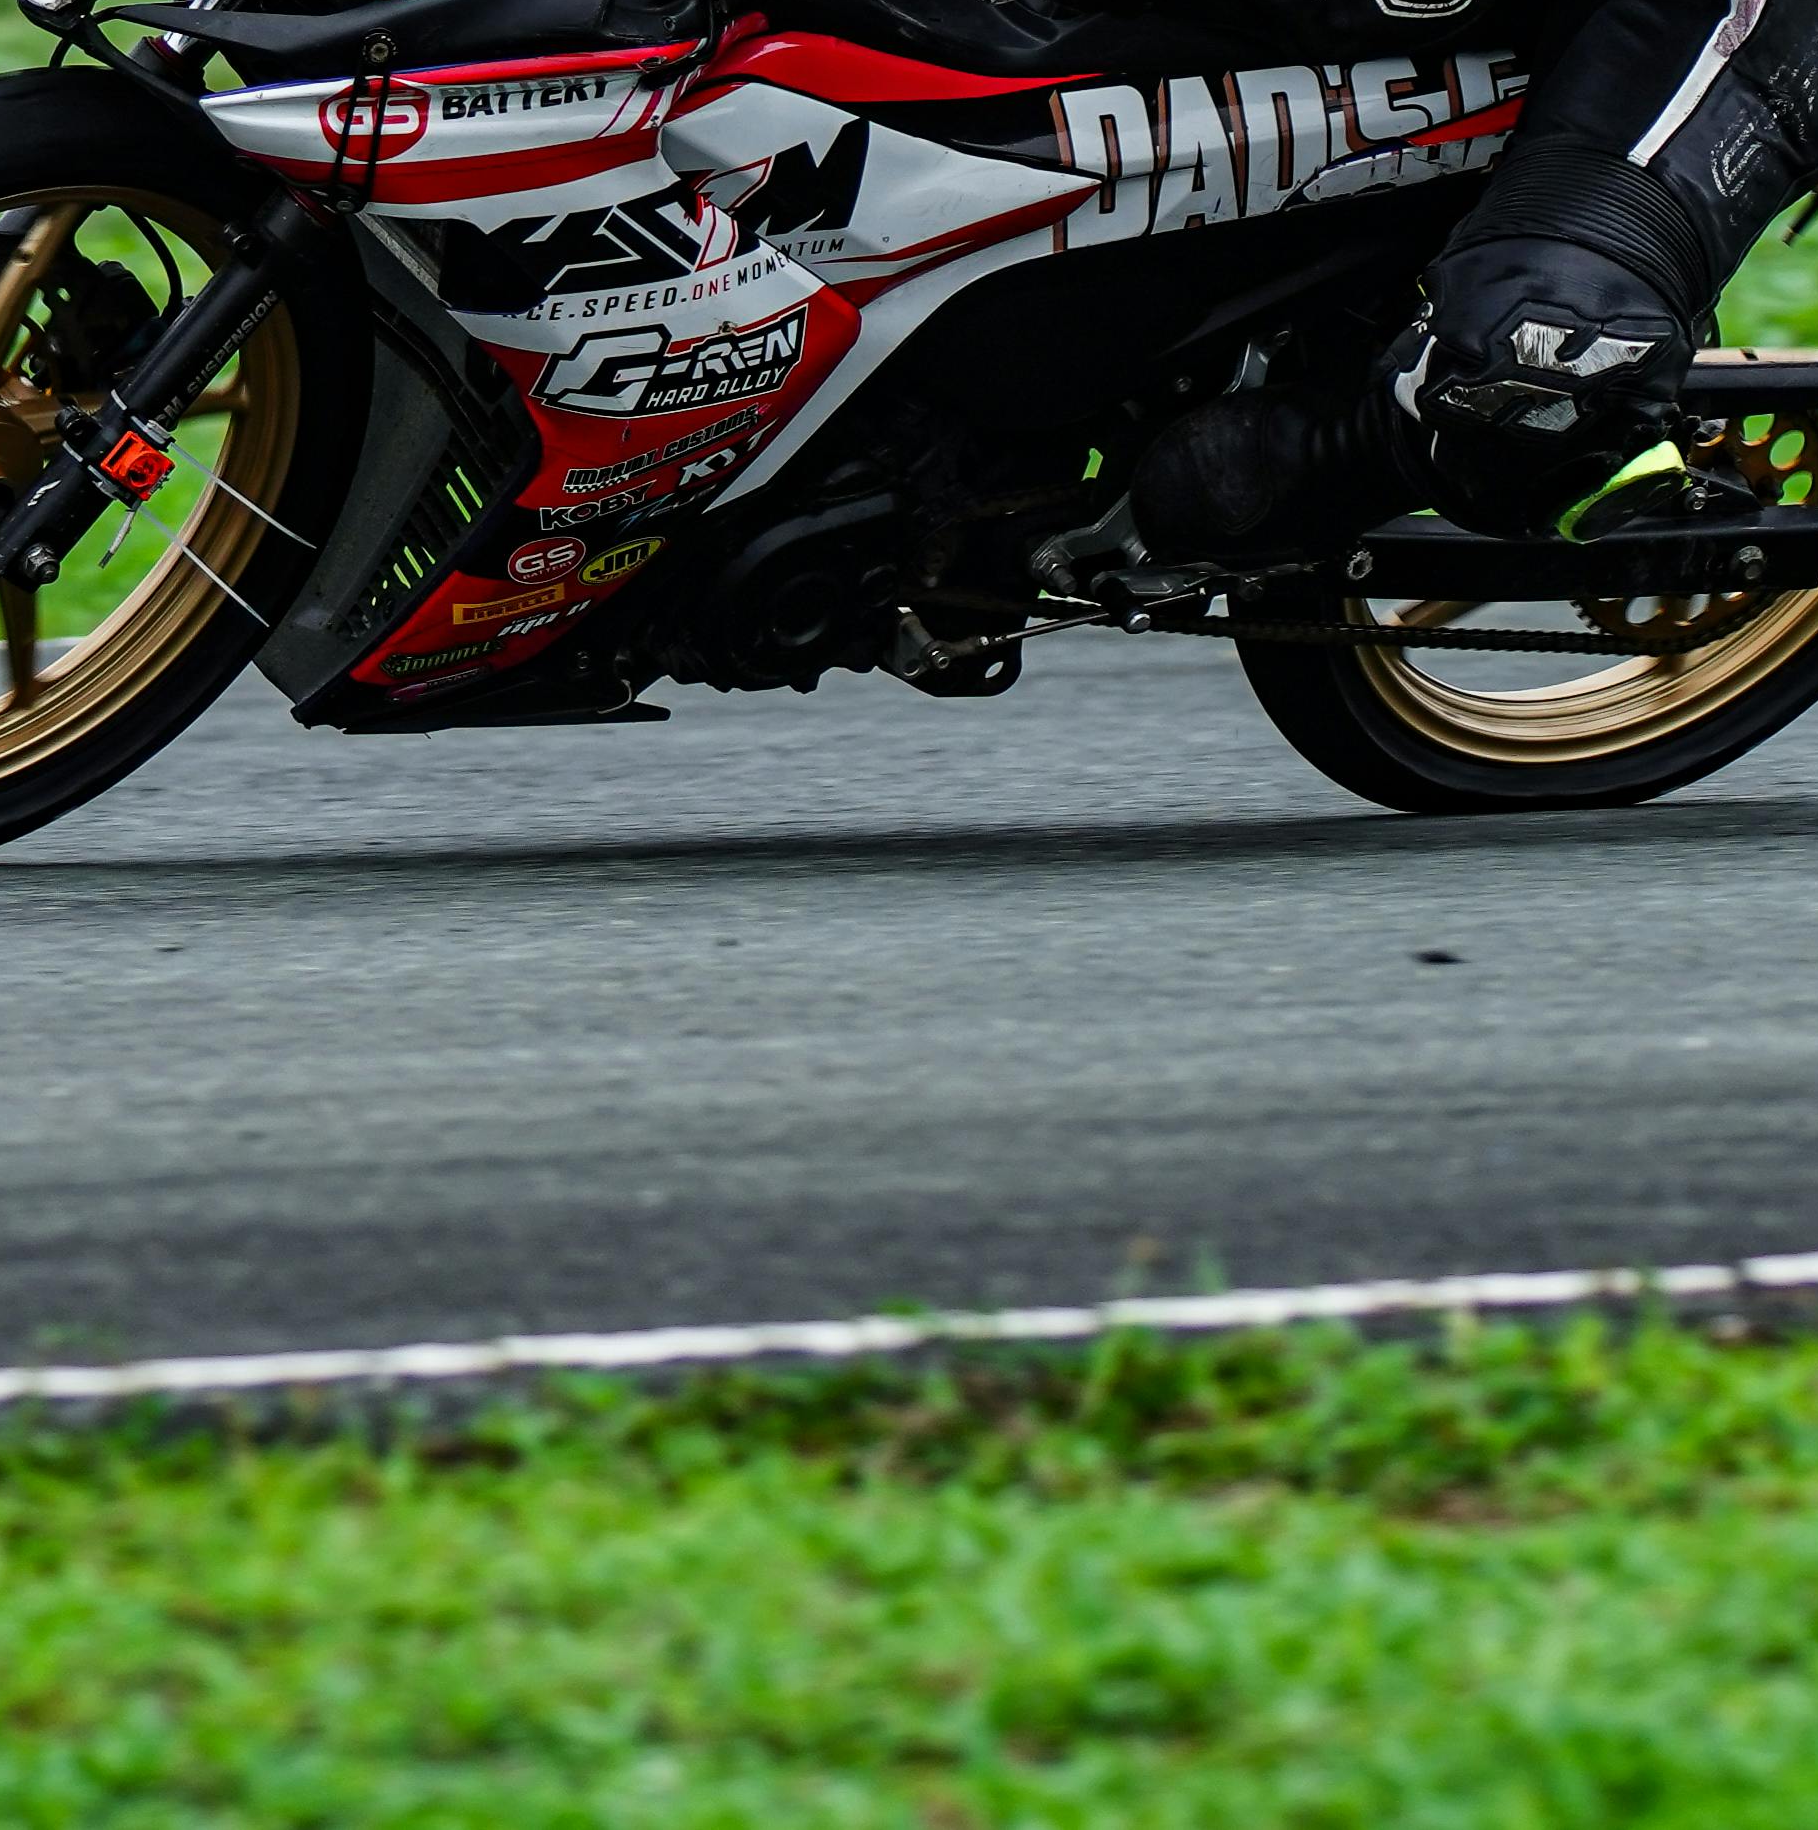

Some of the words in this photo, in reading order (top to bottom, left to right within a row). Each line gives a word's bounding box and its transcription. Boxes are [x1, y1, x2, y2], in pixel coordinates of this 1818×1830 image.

[442, 78, 609, 121] BATTERY
[186, 289, 279, 396] SUSPENSION
[646, 378, 708, 409] HARD
[716, 366, 785, 399] ALLOY
[679, 417, 779, 486] KYT
[540, 479, 658, 531] KOBY
[515, 542, 577, 575] GS
